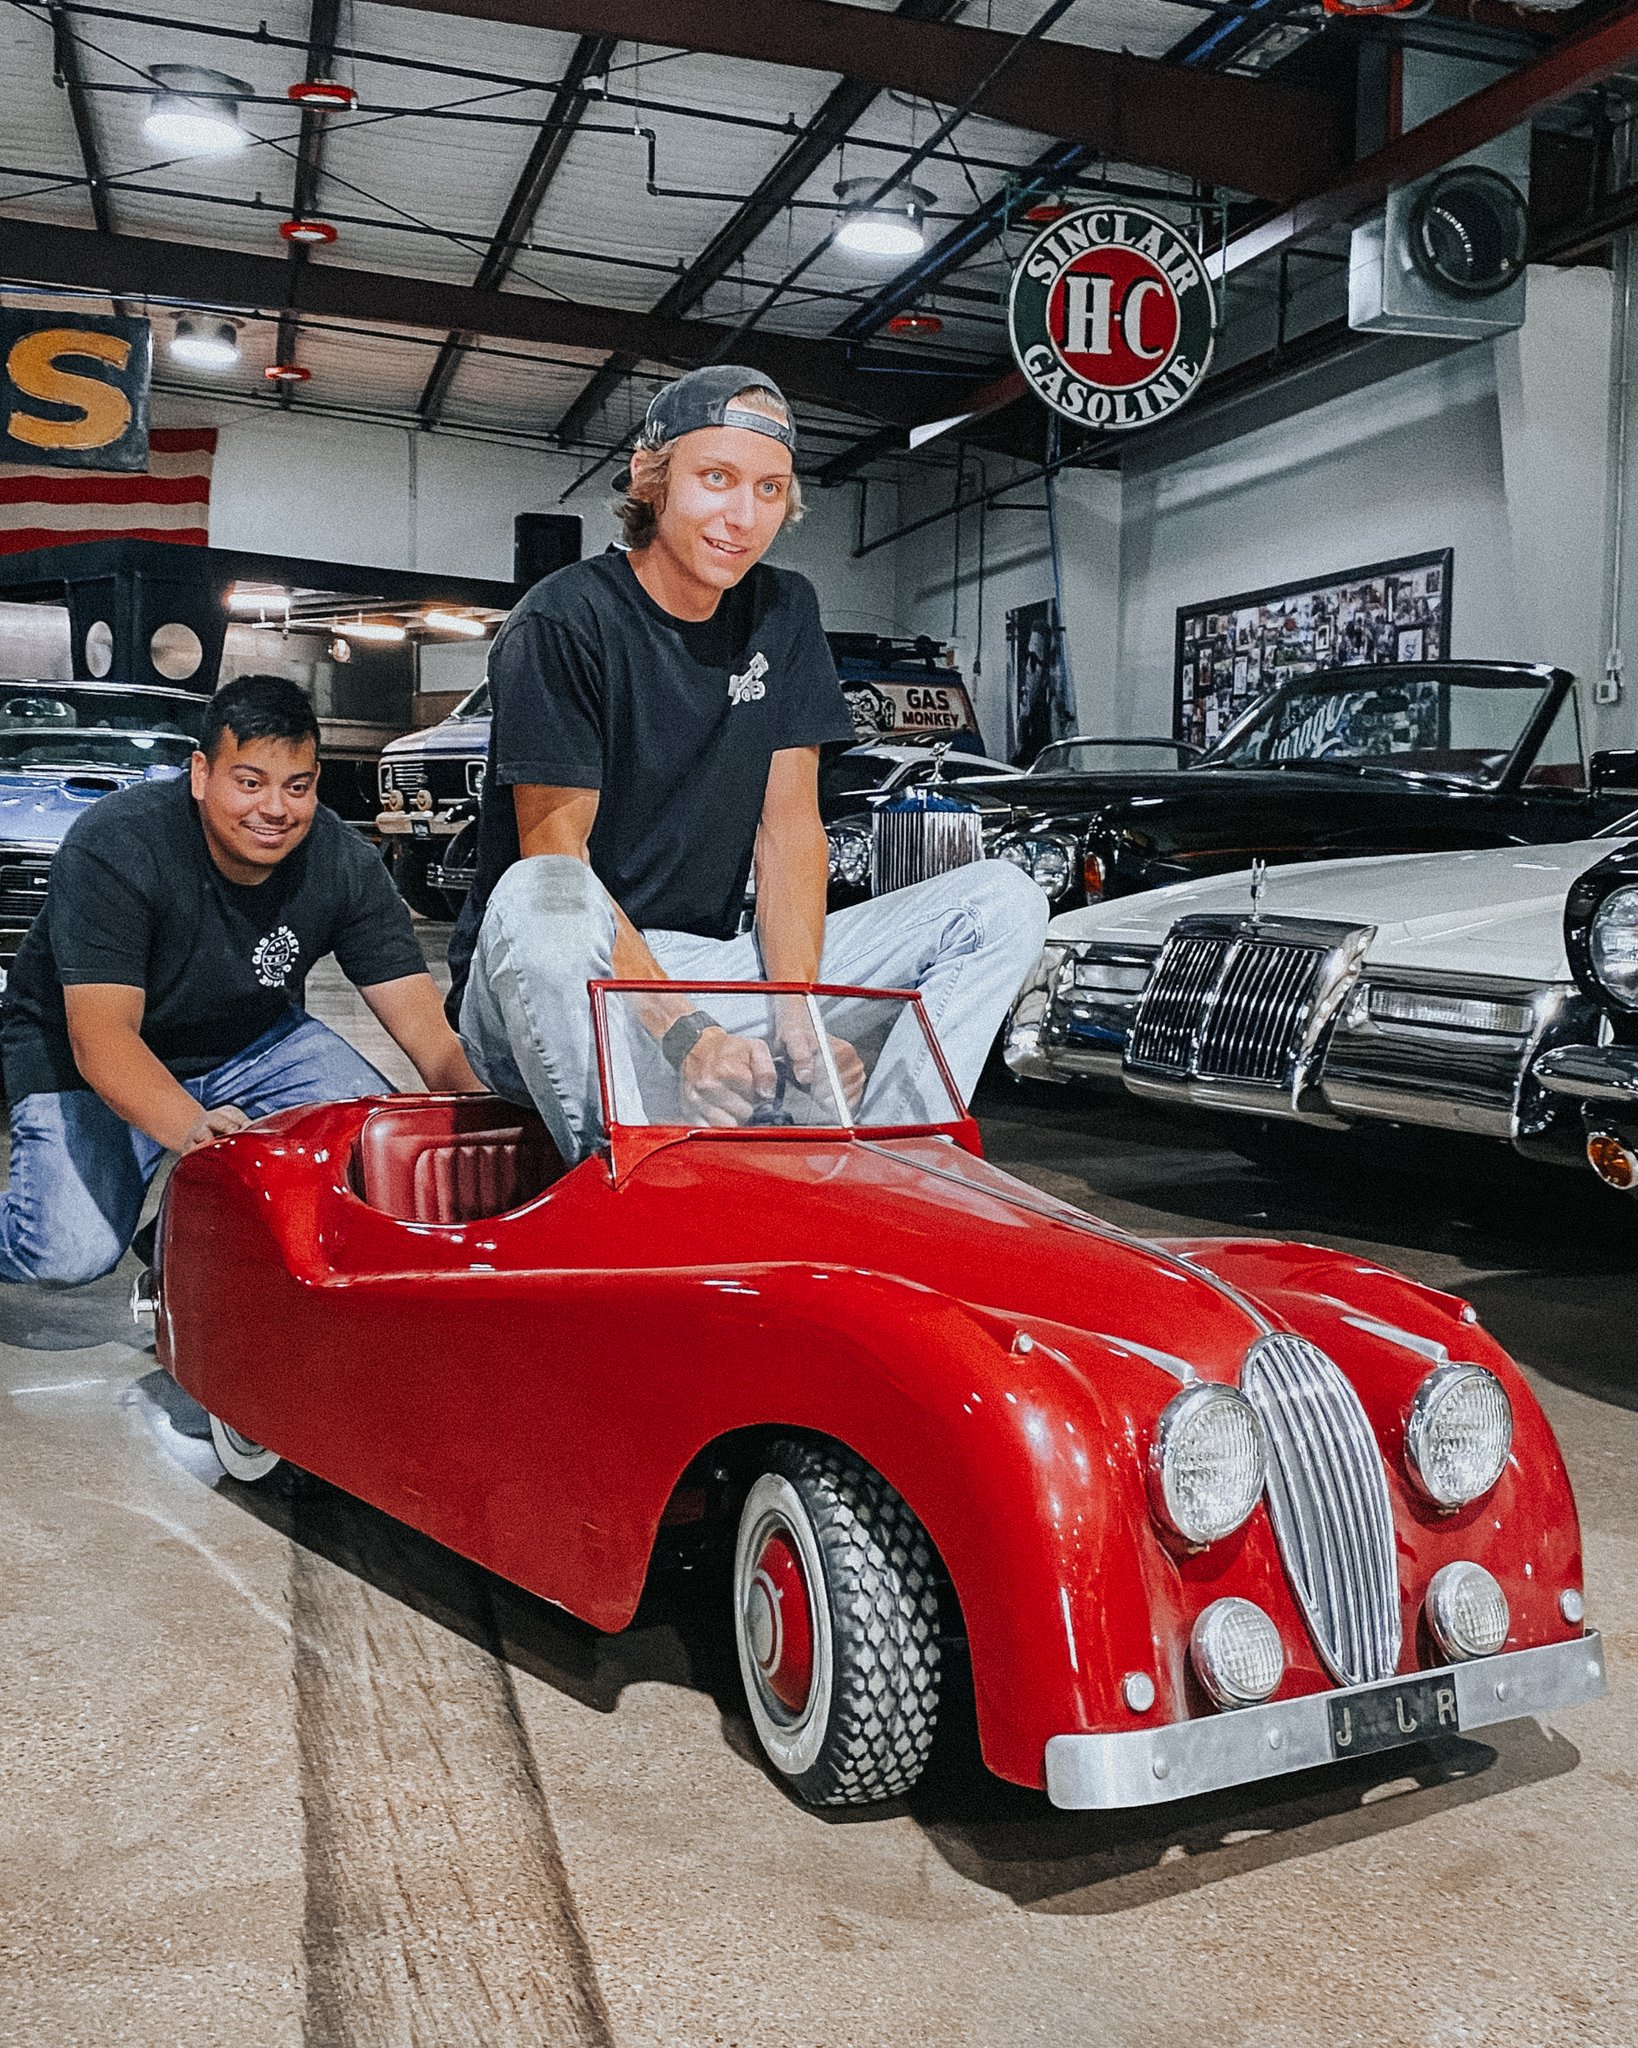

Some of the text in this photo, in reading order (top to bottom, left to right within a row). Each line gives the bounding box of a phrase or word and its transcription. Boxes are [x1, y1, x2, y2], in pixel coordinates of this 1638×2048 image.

[1027, 213, 1200, 296] SINCLAIR
[7, 328, 133, 450] S
[1024, 344, 1200, 424] GASOLINE
[901, 711, 960, 727] MONKEY
[905, 688, 951, 711] GAS
[252, 937, 270, 965] GAS
